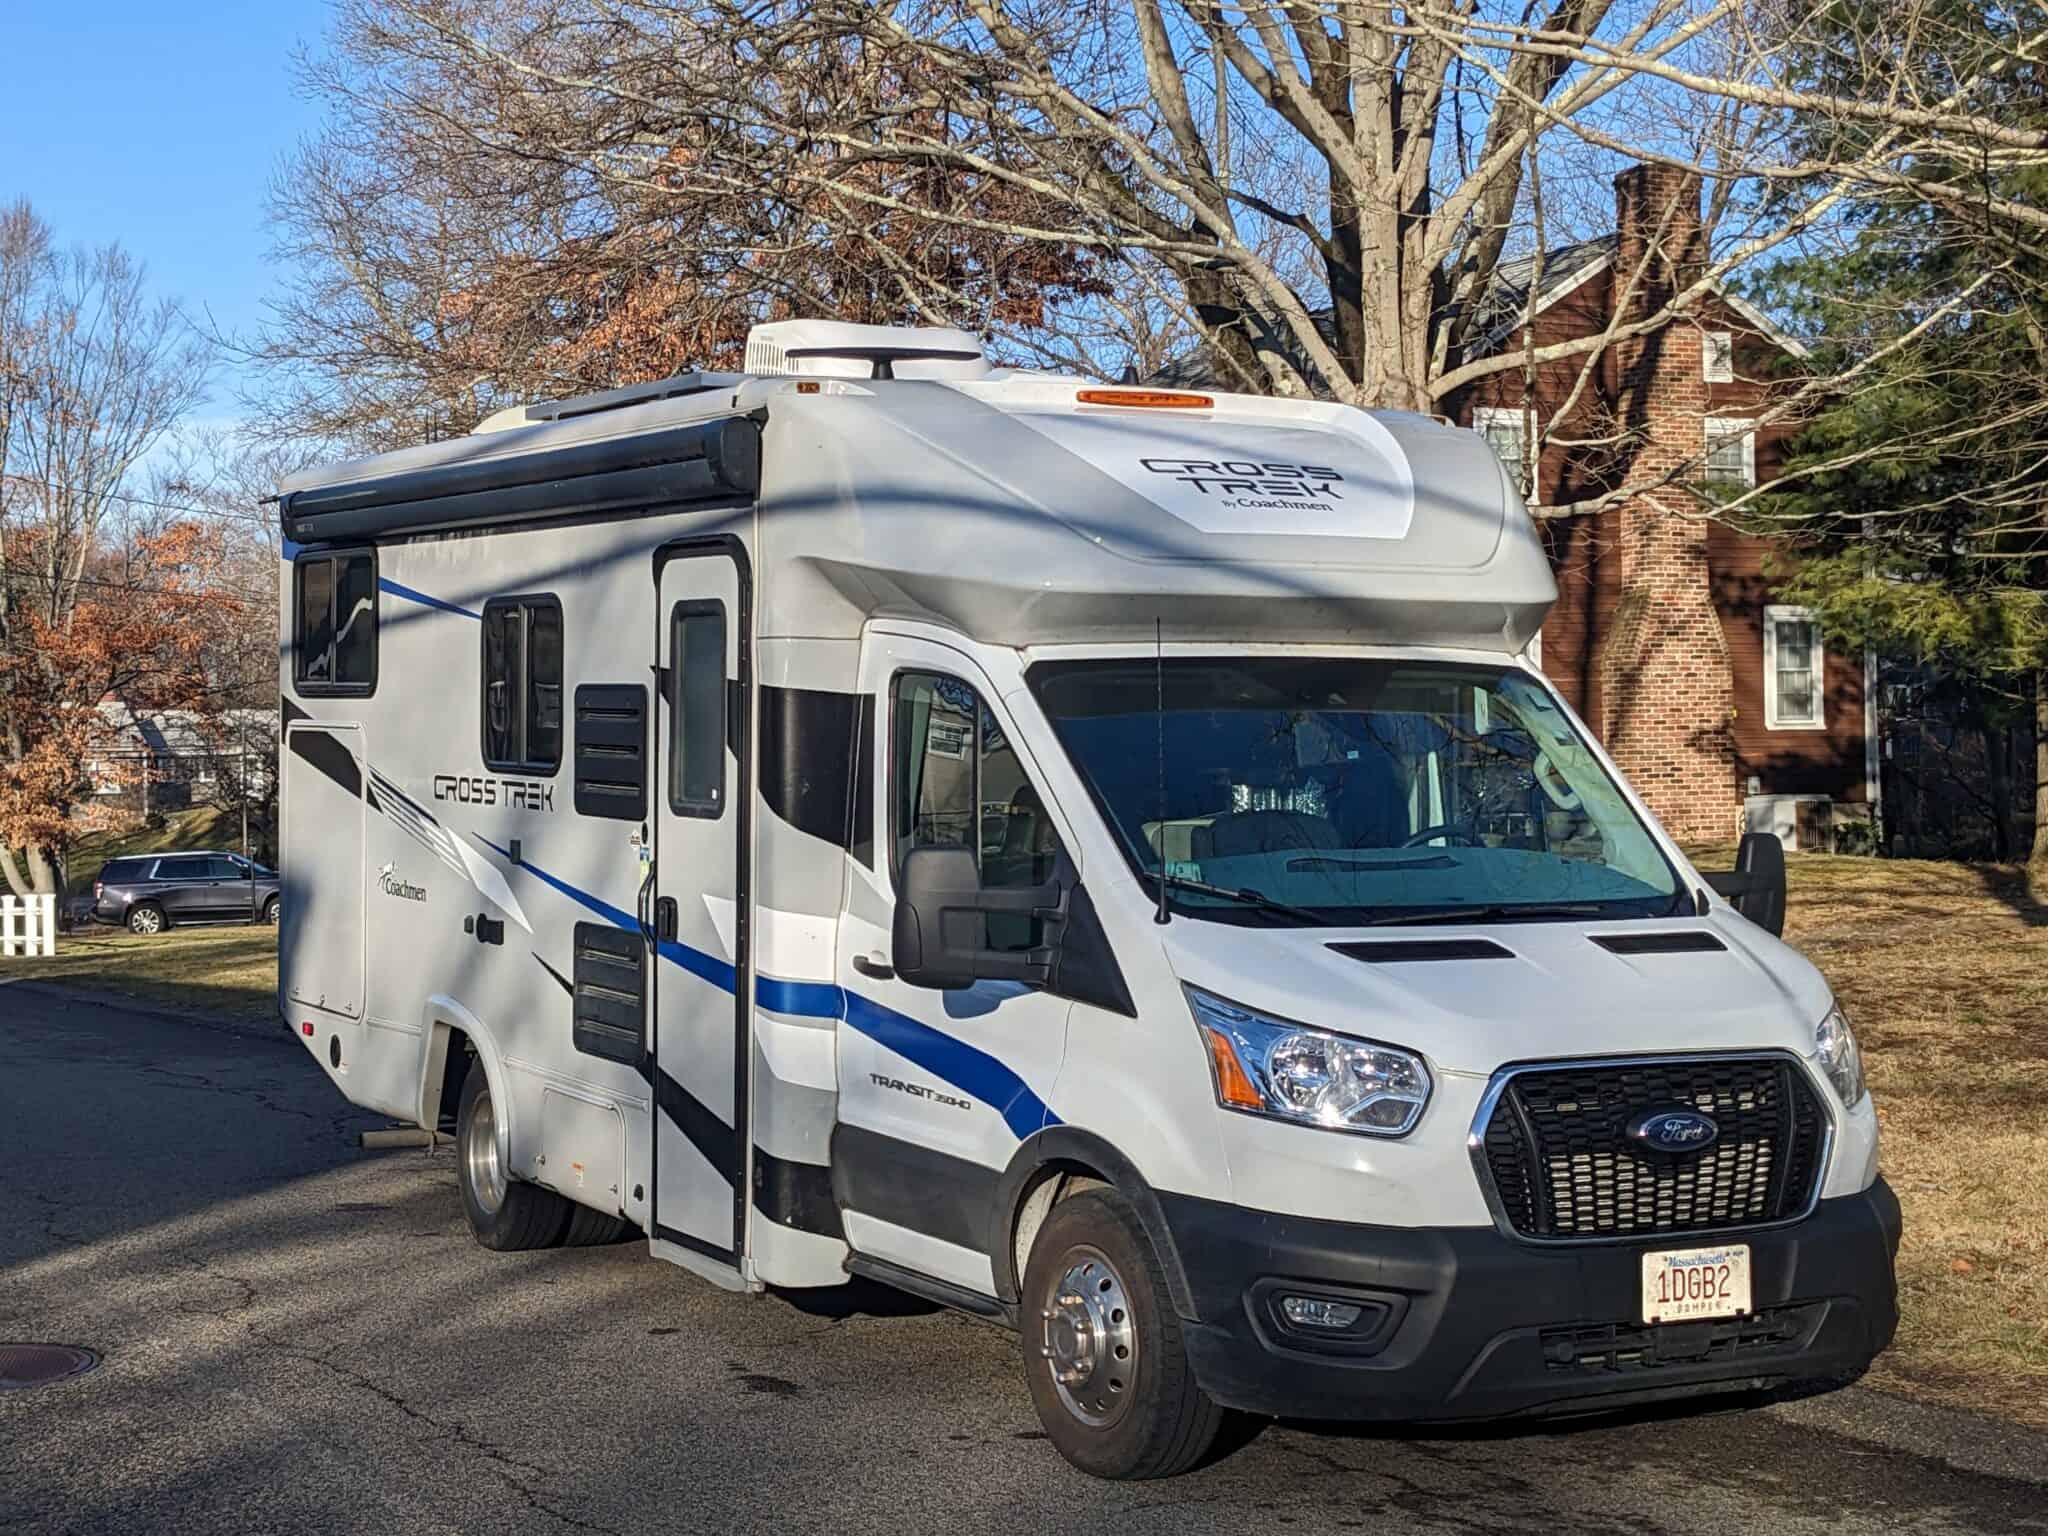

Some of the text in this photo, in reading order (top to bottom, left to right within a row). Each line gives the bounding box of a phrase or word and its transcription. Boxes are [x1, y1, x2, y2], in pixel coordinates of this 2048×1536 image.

[1140, 458, 1344, 480] CROSS
[1177, 477, 1344, 499] TREK
[1237, 498, 1334, 511] Coachmen
[434, 775, 554, 812] CROSS TREK
[386, 878, 427, 902] Coachmen
[869, 1073, 934, 1099] TRANSIT
[1661, 1119, 1704, 1142] Ford
[1658, 1265, 1730, 1303] 1DGB2
